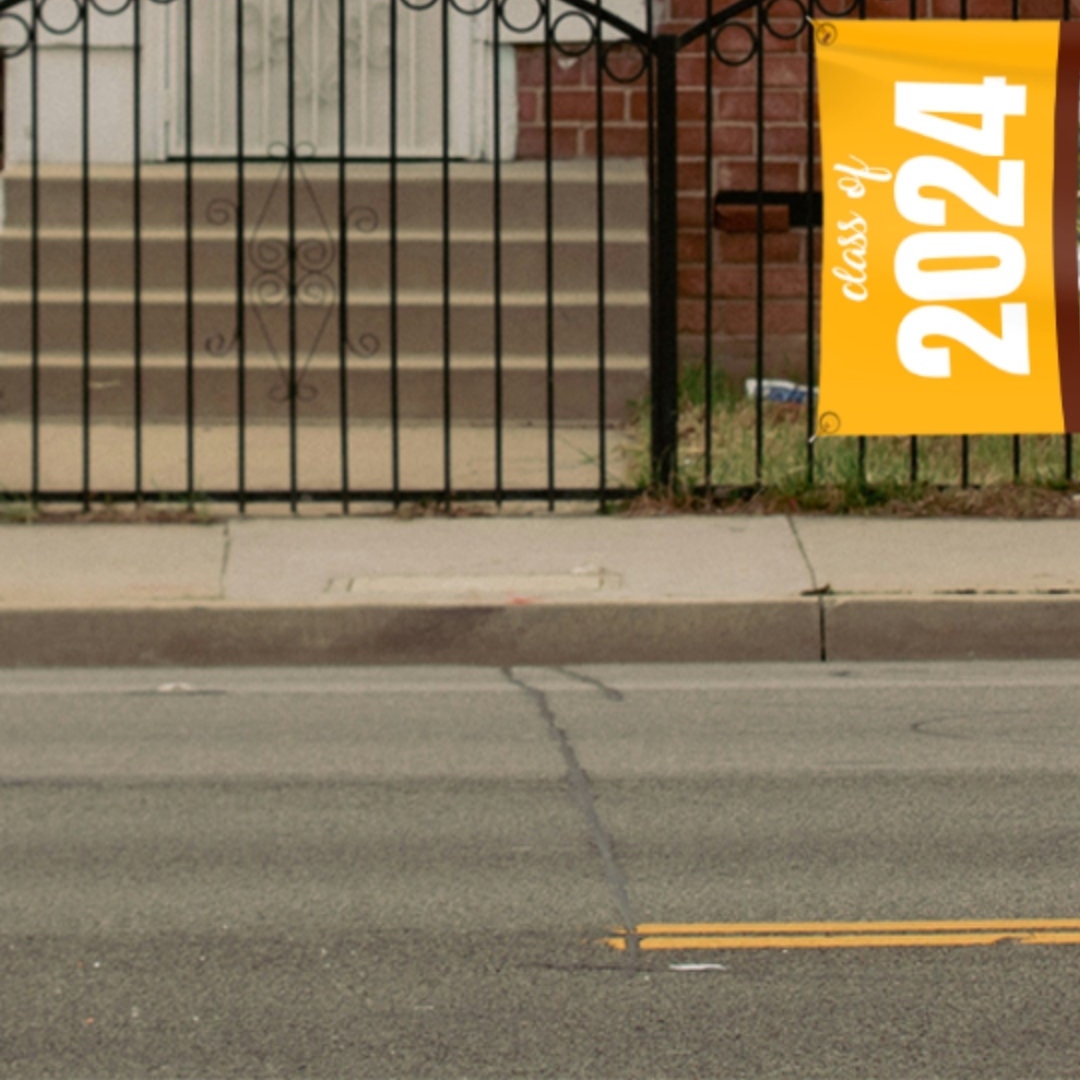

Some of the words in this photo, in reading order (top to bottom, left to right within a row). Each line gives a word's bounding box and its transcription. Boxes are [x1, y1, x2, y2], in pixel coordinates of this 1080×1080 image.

[833, 154, 893, 199] of
[831, 210, 868, 302] class
[893, 76, 1030, 378] 2024
